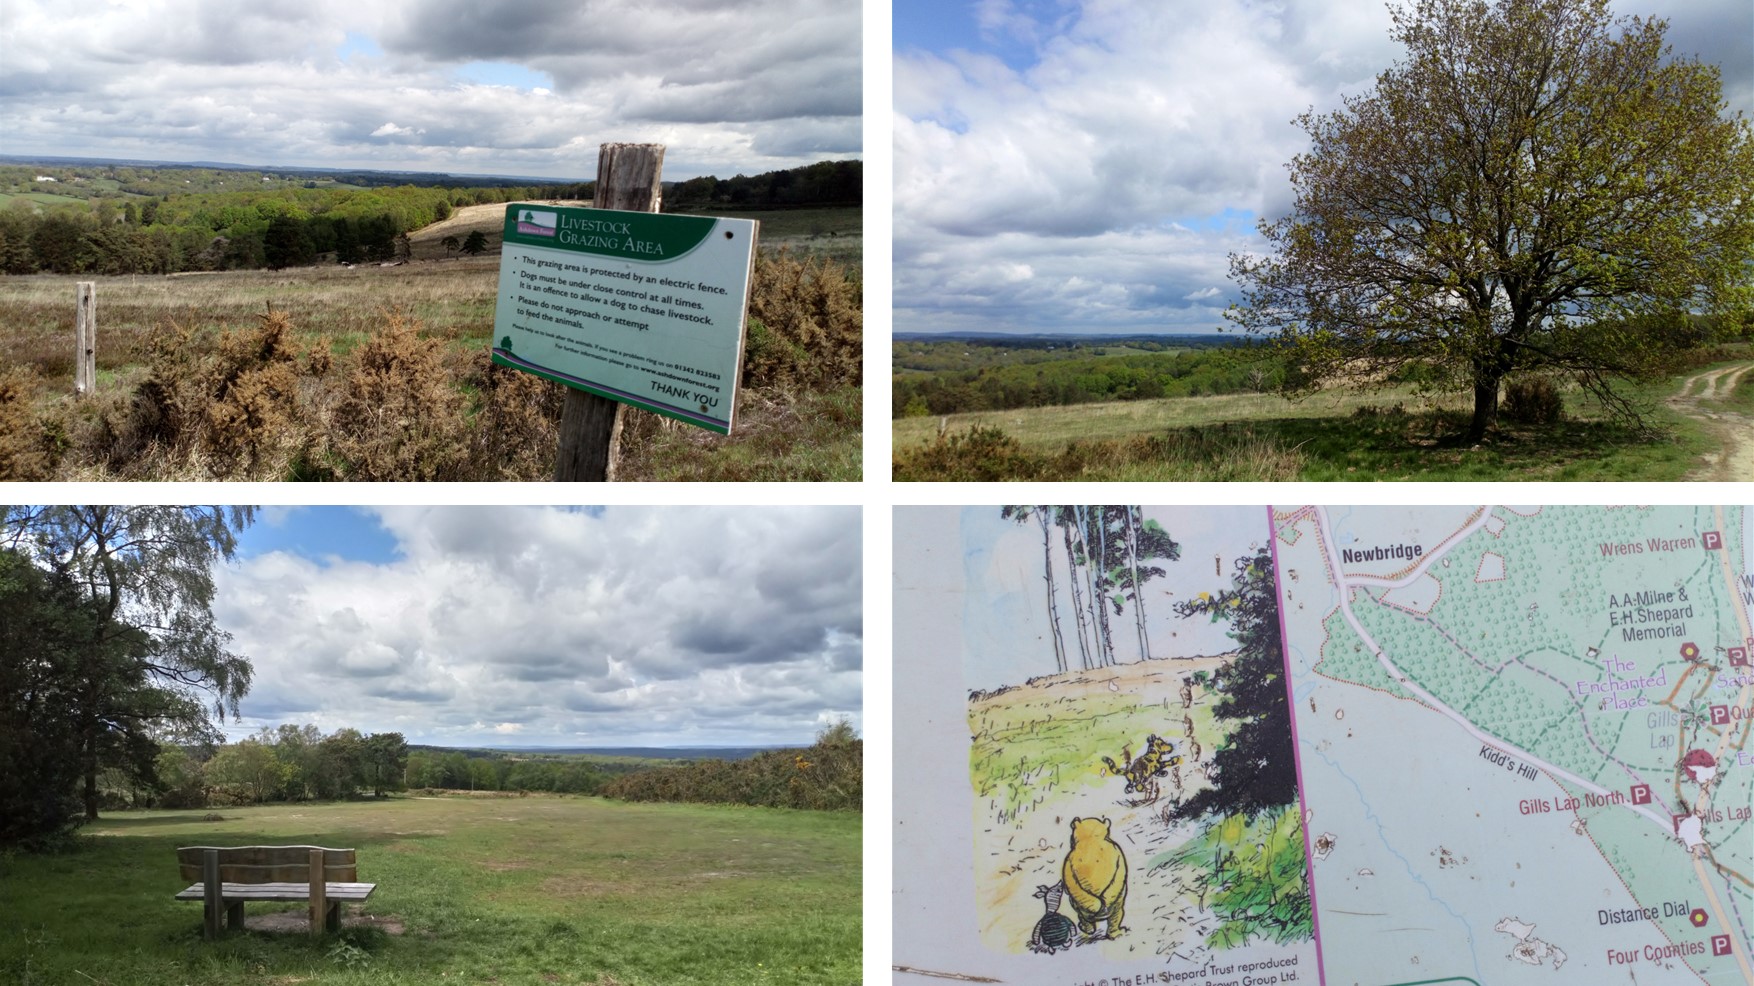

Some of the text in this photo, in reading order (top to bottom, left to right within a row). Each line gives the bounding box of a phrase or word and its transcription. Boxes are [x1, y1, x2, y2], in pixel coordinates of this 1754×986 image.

[562, 215, 631, 235] LIVESTOCK
[560, 230, 618, 249] GRAZING
[622, 237, 664, 255] AREA
[523, 256, 728, 295] This grazing area is protected by an electric fence.
[521, 271, 537, 281] Dogs
[539, 275, 556, 283] must
[558, 277, 567, 285] be
[569, 280, 591, 289] under
[593, 284, 613, 293] close
[616, 288, 647, 300] control
[661, 296, 672, 304] all
[675, 298, 704, 310] times.
[518, 296, 539, 306] Please
[540, 301, 549, 309] do
[551, 304, 564, 312] not
[565, 307, 601, 320] approach
[614, 317, 649, 331] attempt
[543, 287, 568, 297] offence
[580, 293, 601, 304] allow
[610, 299, 626, 310] dog
[640, 305, 666, 316] chase
[668, 309, 714, 326] livestock.
[526, 309, 540, 319] feed
[542, 313, 553, 322] the
[555, 317, 584, 329] animals.
[564, 345, 579, 354] further
[580, 351, 608, 361] information
[609, 358, 624, 366] please
[641, 367, 720, 392] www.ashdownforest.org
[623, 352, 645, 361] problem
[674, 364, 694, 373] 01342
[696, 370, 720, 380] 823583
[651, 381, 718, 407] THANK YOU
[1342, 544, 1423, 564] Newbridge
[1599, 537, 1696, 557] Wrens Warren
[1679, 587, 1688, 601] &
[1622, 623, 1686, 642] Memorial
[1603, 655, 1635, 673] The
[1576, 668, 1666, 695] Enchanted
[1602, 692, 1647, 710] Place
[1647, 711, 1678, 729] Gills
[1651, 733, 1674, 750] Lap
[1479, 744, 1538, 781] Kidd's Hill
[1519, 791, 1624, 815] Gills Lap North
[1727, 806, 1752, 821] Lap
[1598, 900, 1690, 926] Distance Dial
[1608, 940, 1705, 965] Four Counties
[1112, 977, 1132, 986] The
[1136, 974, 1158, 986] E.H.
[1160, 966, 1207, 983] Shepard
[1210, 964, 1234, 975] Trust
[1238, 954, 1298, 973] reproduced
[1242, 976, 1277, 986] Group
[1281, 970, 1299, 982] Ltd.
